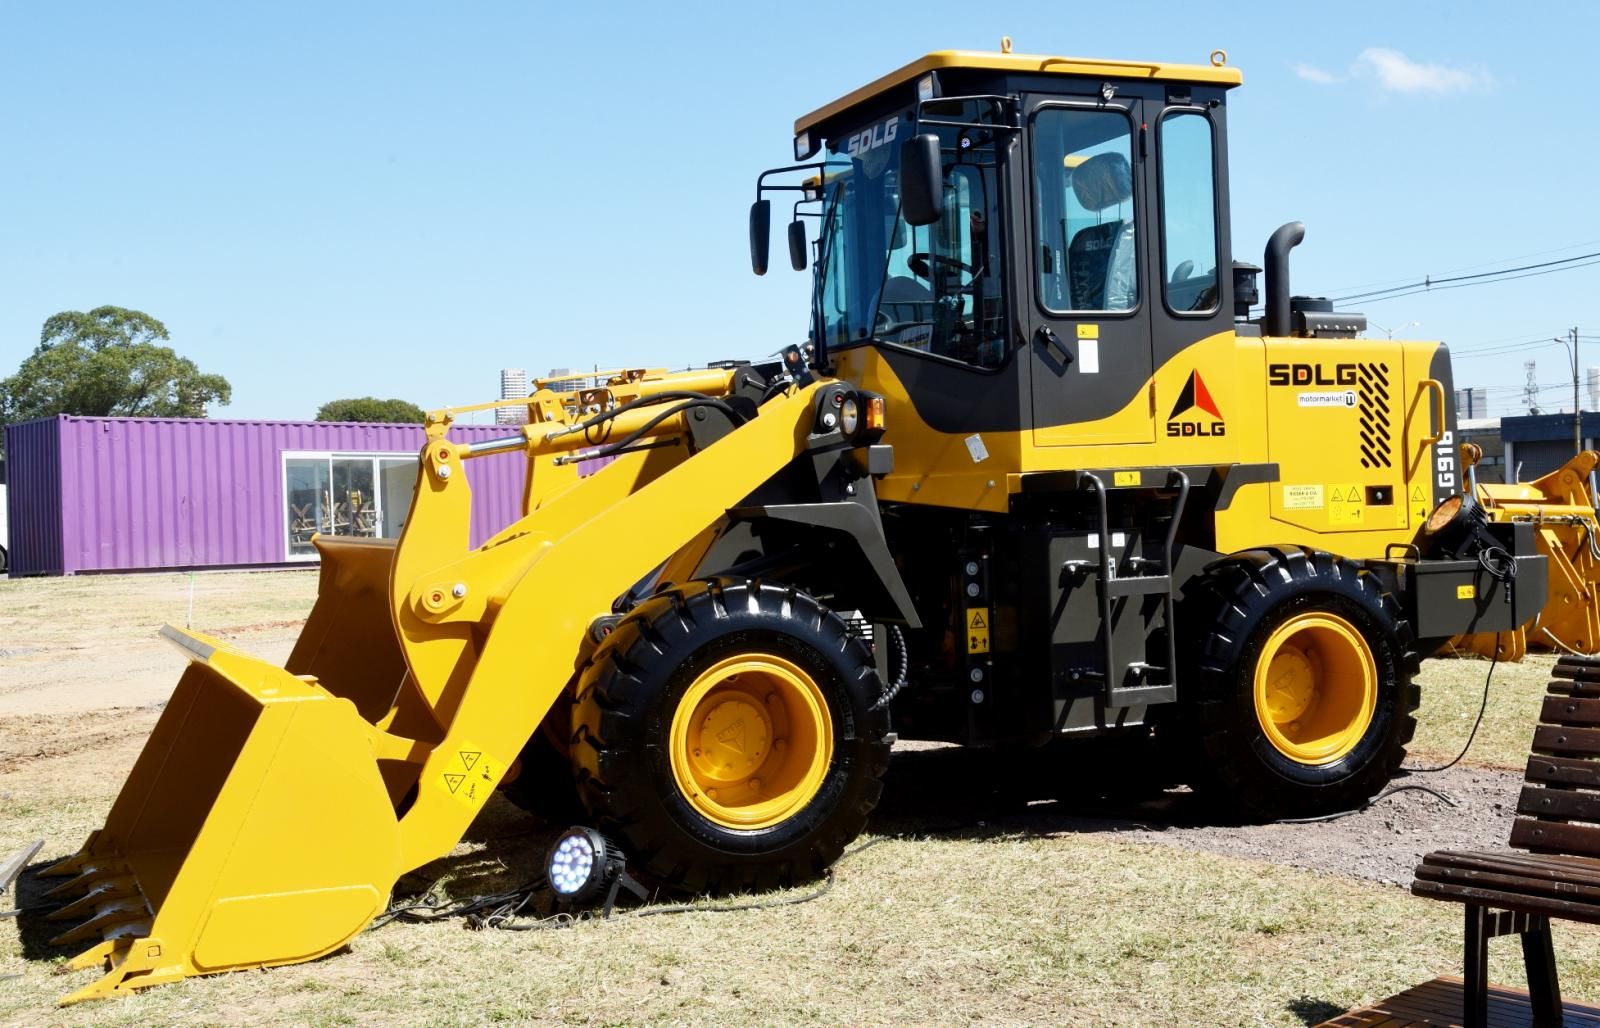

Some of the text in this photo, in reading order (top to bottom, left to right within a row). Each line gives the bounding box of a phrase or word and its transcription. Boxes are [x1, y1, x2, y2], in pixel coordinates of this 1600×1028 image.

[848, 116, 899, 158] SDLG
[1269, 363, 1357, 386] SDLG
[1299, 394, 1342, 403] motormarket
[1167, 422, 1225, 437] SDLG
